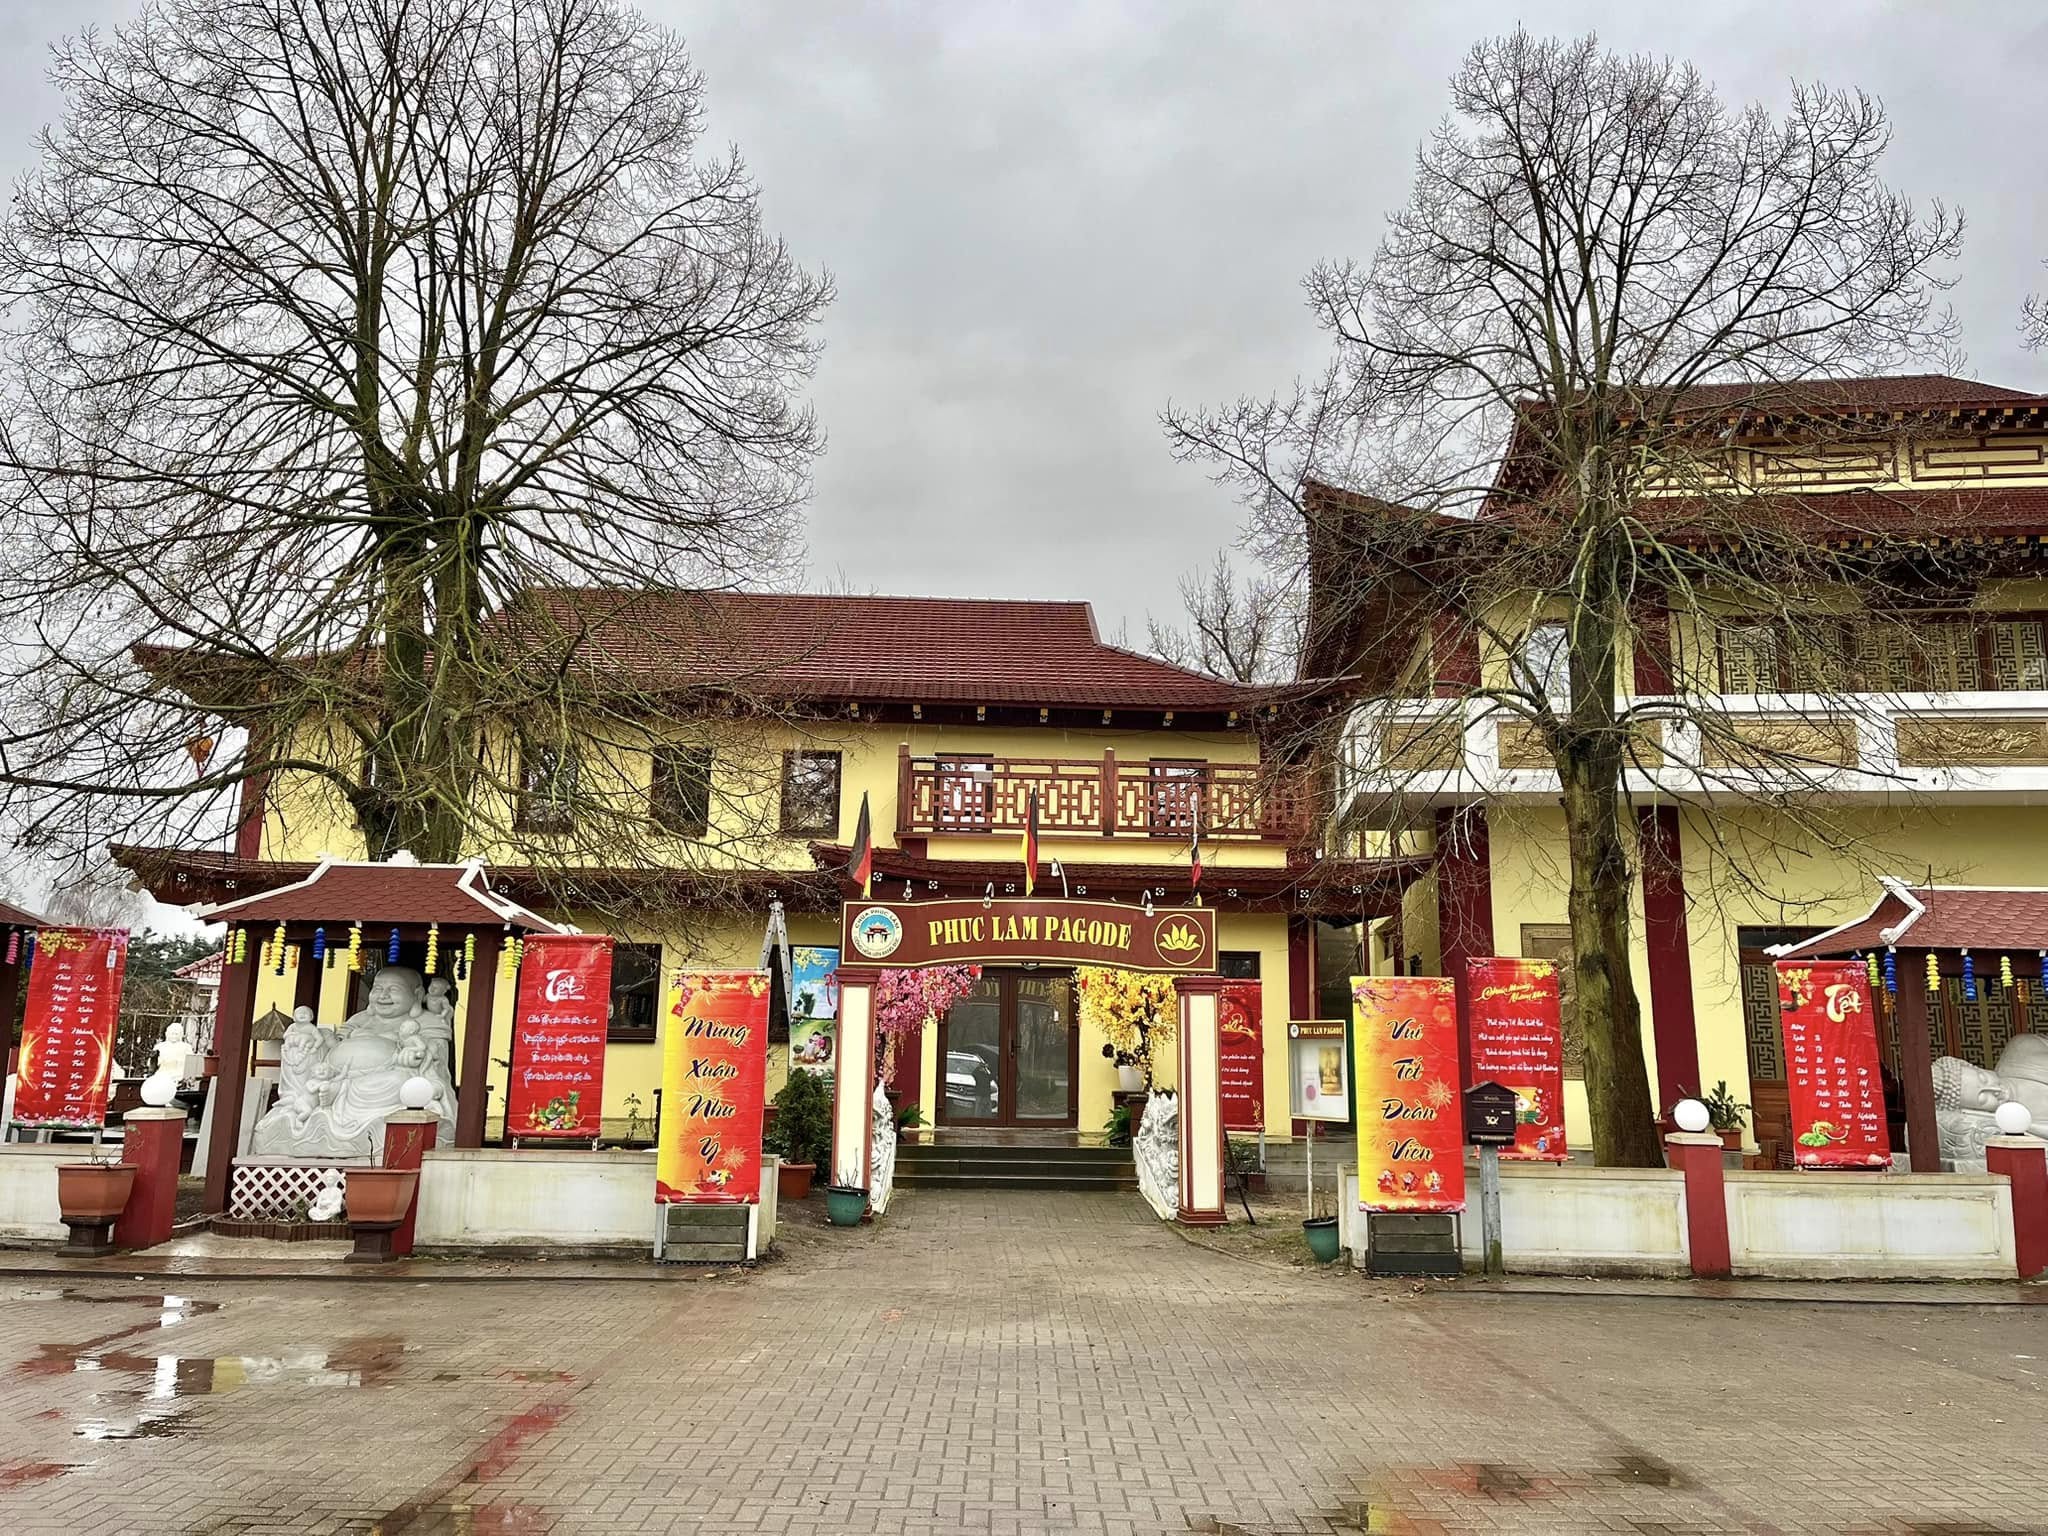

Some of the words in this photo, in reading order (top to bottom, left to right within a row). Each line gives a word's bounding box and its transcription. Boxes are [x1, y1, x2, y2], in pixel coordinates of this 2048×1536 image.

[928, 916, 985, 946] PHUC
[991, 914, 1038, 942] LAM
[1044, 916, 1133, 951] PAGODE
[683, 1016, 748, 1045] Mừng
[1387, 1018, 1423, 1040] Vui
[686, 1058, 738, 1080] Xuân
[1393, 1057, 1423, 1081] Tết
[688, 1095, 736, 1118] Như
[1382, 1098, 1437, 1120] Đoàn
[699, 1133, 721, 1164] Ý
[1388, 1137, 1433, 1161] Viên
